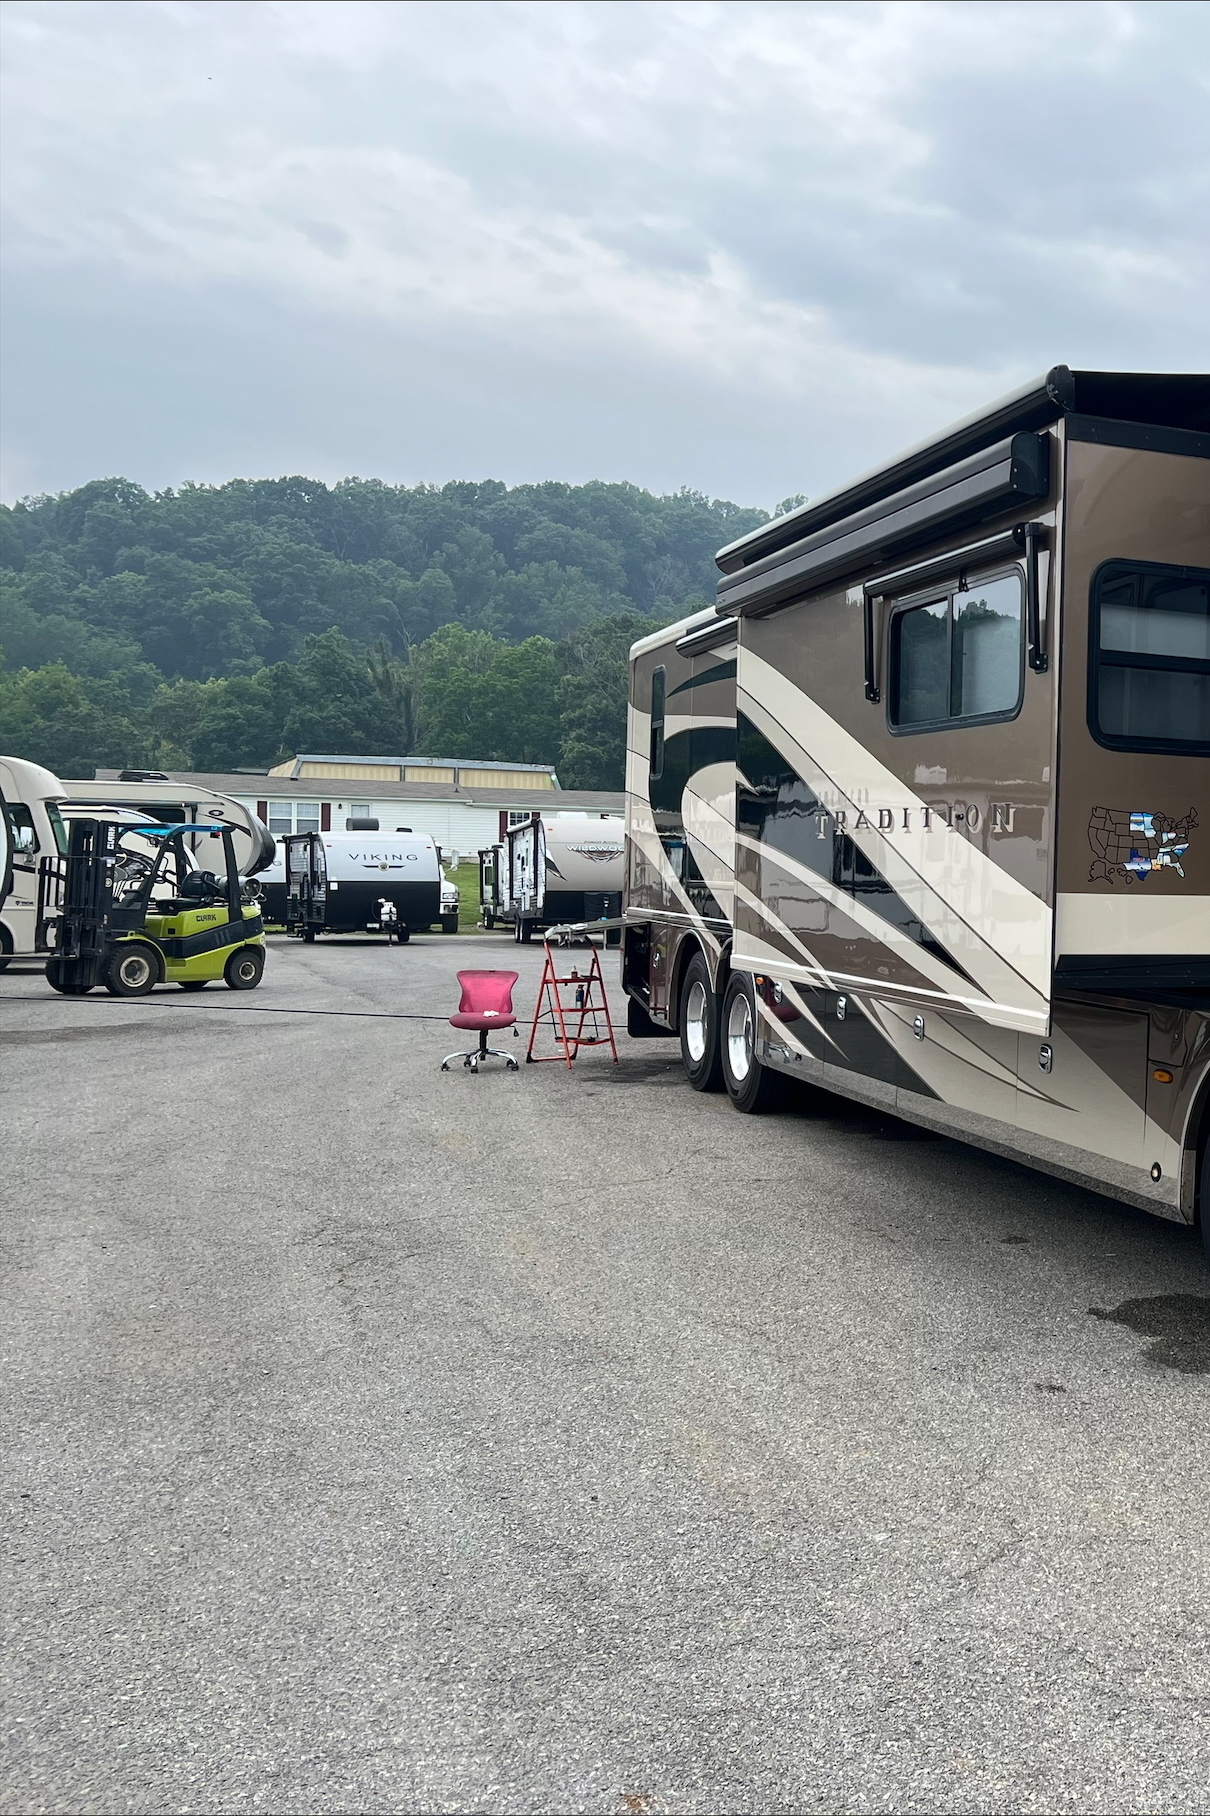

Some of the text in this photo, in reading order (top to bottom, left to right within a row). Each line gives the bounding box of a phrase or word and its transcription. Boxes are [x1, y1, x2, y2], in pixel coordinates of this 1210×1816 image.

[814, 802, 1016, 839] TRADITION
[106, 825, 116, 850] CLARK
[348, 853, 418, 861] VIKING
[195, 914, 217, 922] CLARK
